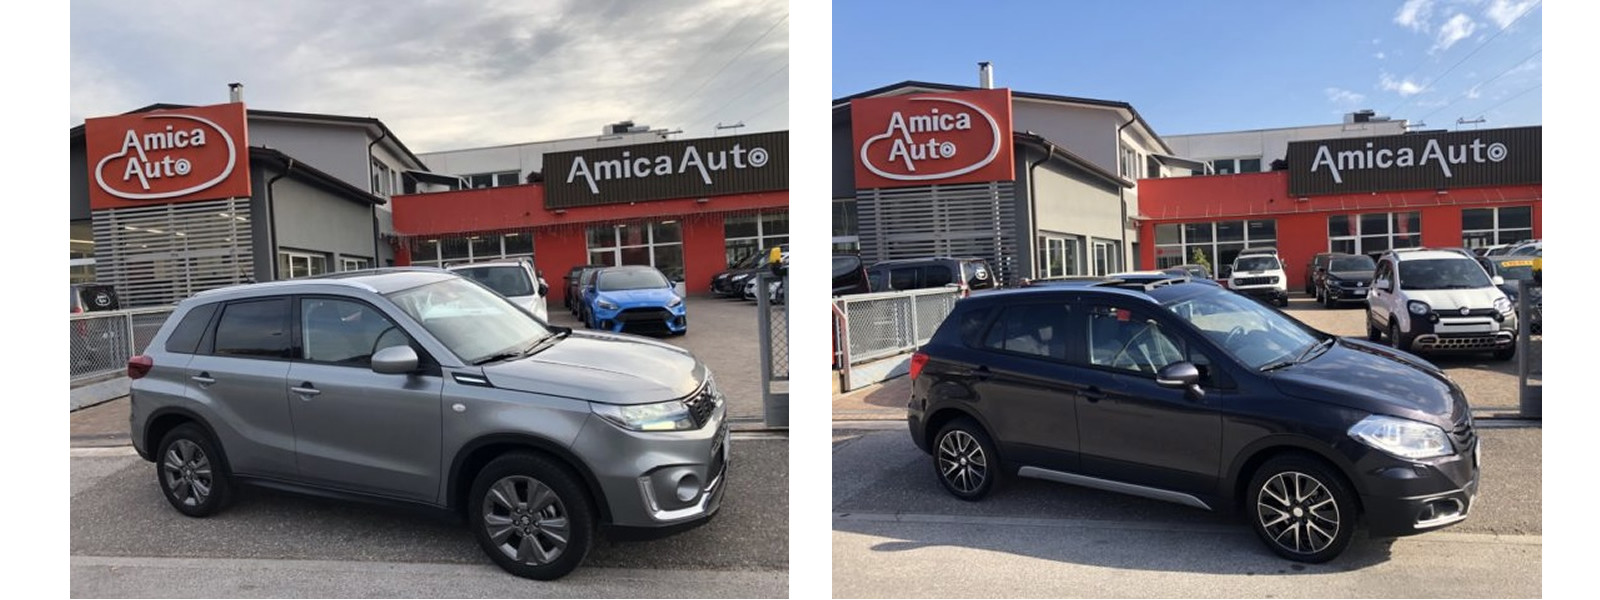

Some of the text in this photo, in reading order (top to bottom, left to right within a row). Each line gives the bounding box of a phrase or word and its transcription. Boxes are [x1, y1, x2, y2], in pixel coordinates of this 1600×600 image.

[121, 125, 205, 161] Amica
[888, 109, 971, 143] Amica
[124, 154, 191, 189] Auto
[566, 144, 769, 194] Amica Auto
[888, 138, 957, 171] Auto
[1311, 139, 1508, 184] Amica Auto
